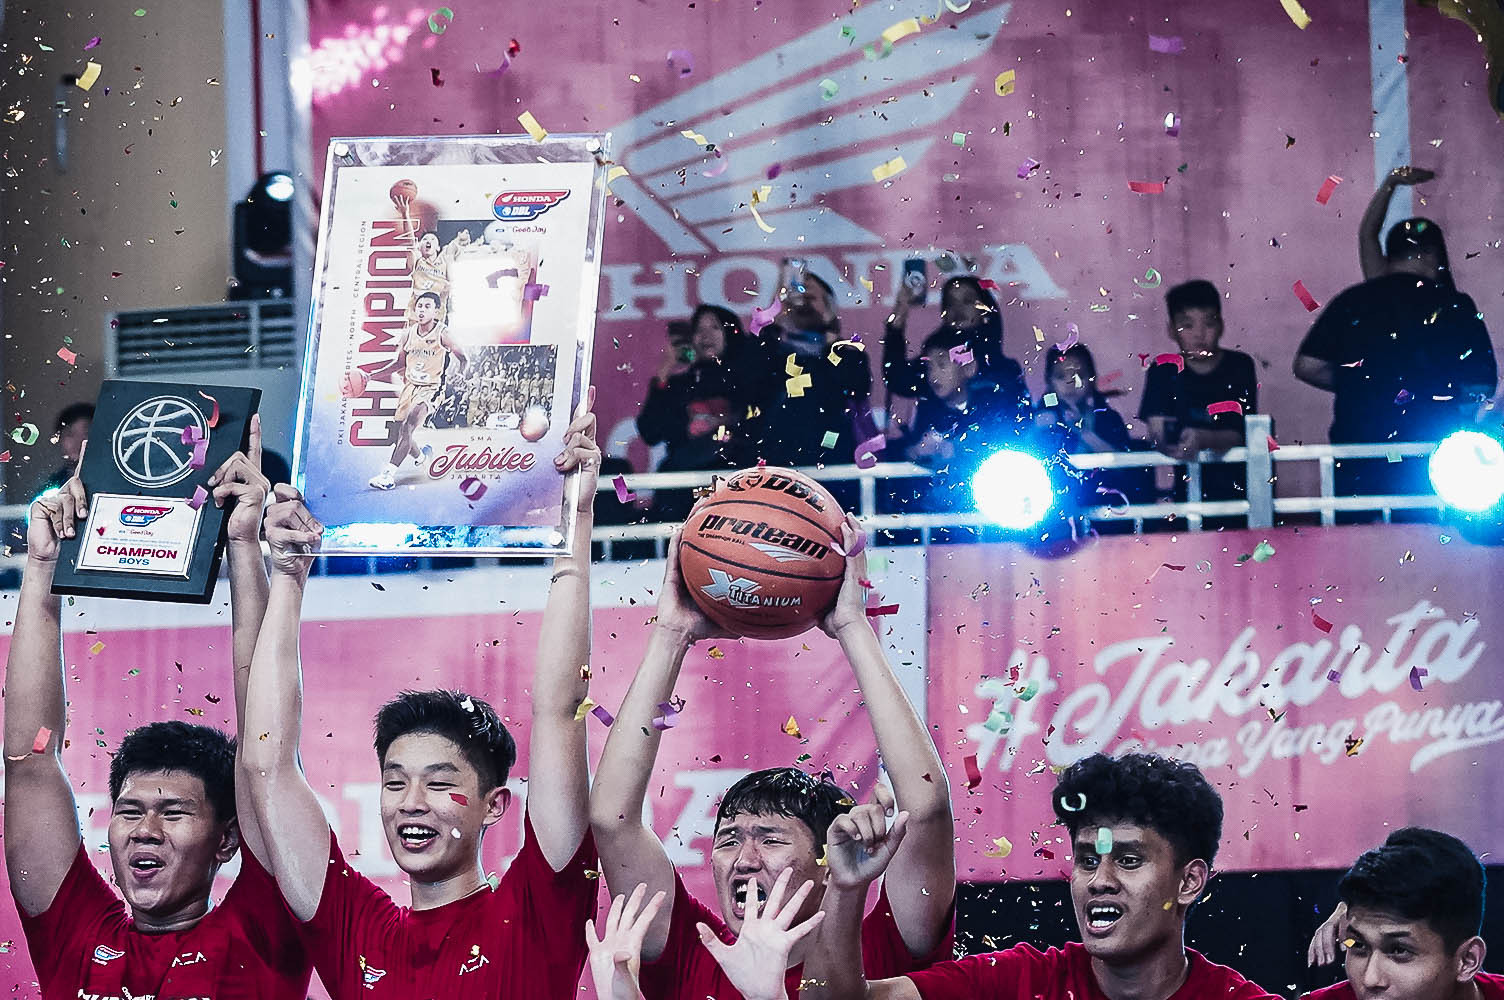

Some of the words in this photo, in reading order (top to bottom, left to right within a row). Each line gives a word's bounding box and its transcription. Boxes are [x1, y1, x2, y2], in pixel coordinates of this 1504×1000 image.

[349, 219, 420, 447] CHAMPION
[429, 445, 535, 479] Jubilee
[760, 474, 826, 514] DBL
[97, 545, 177, 559] CHAMPION
[698, 514, 831, 560] proteam
[119, 557, 150, 565] BOYS
